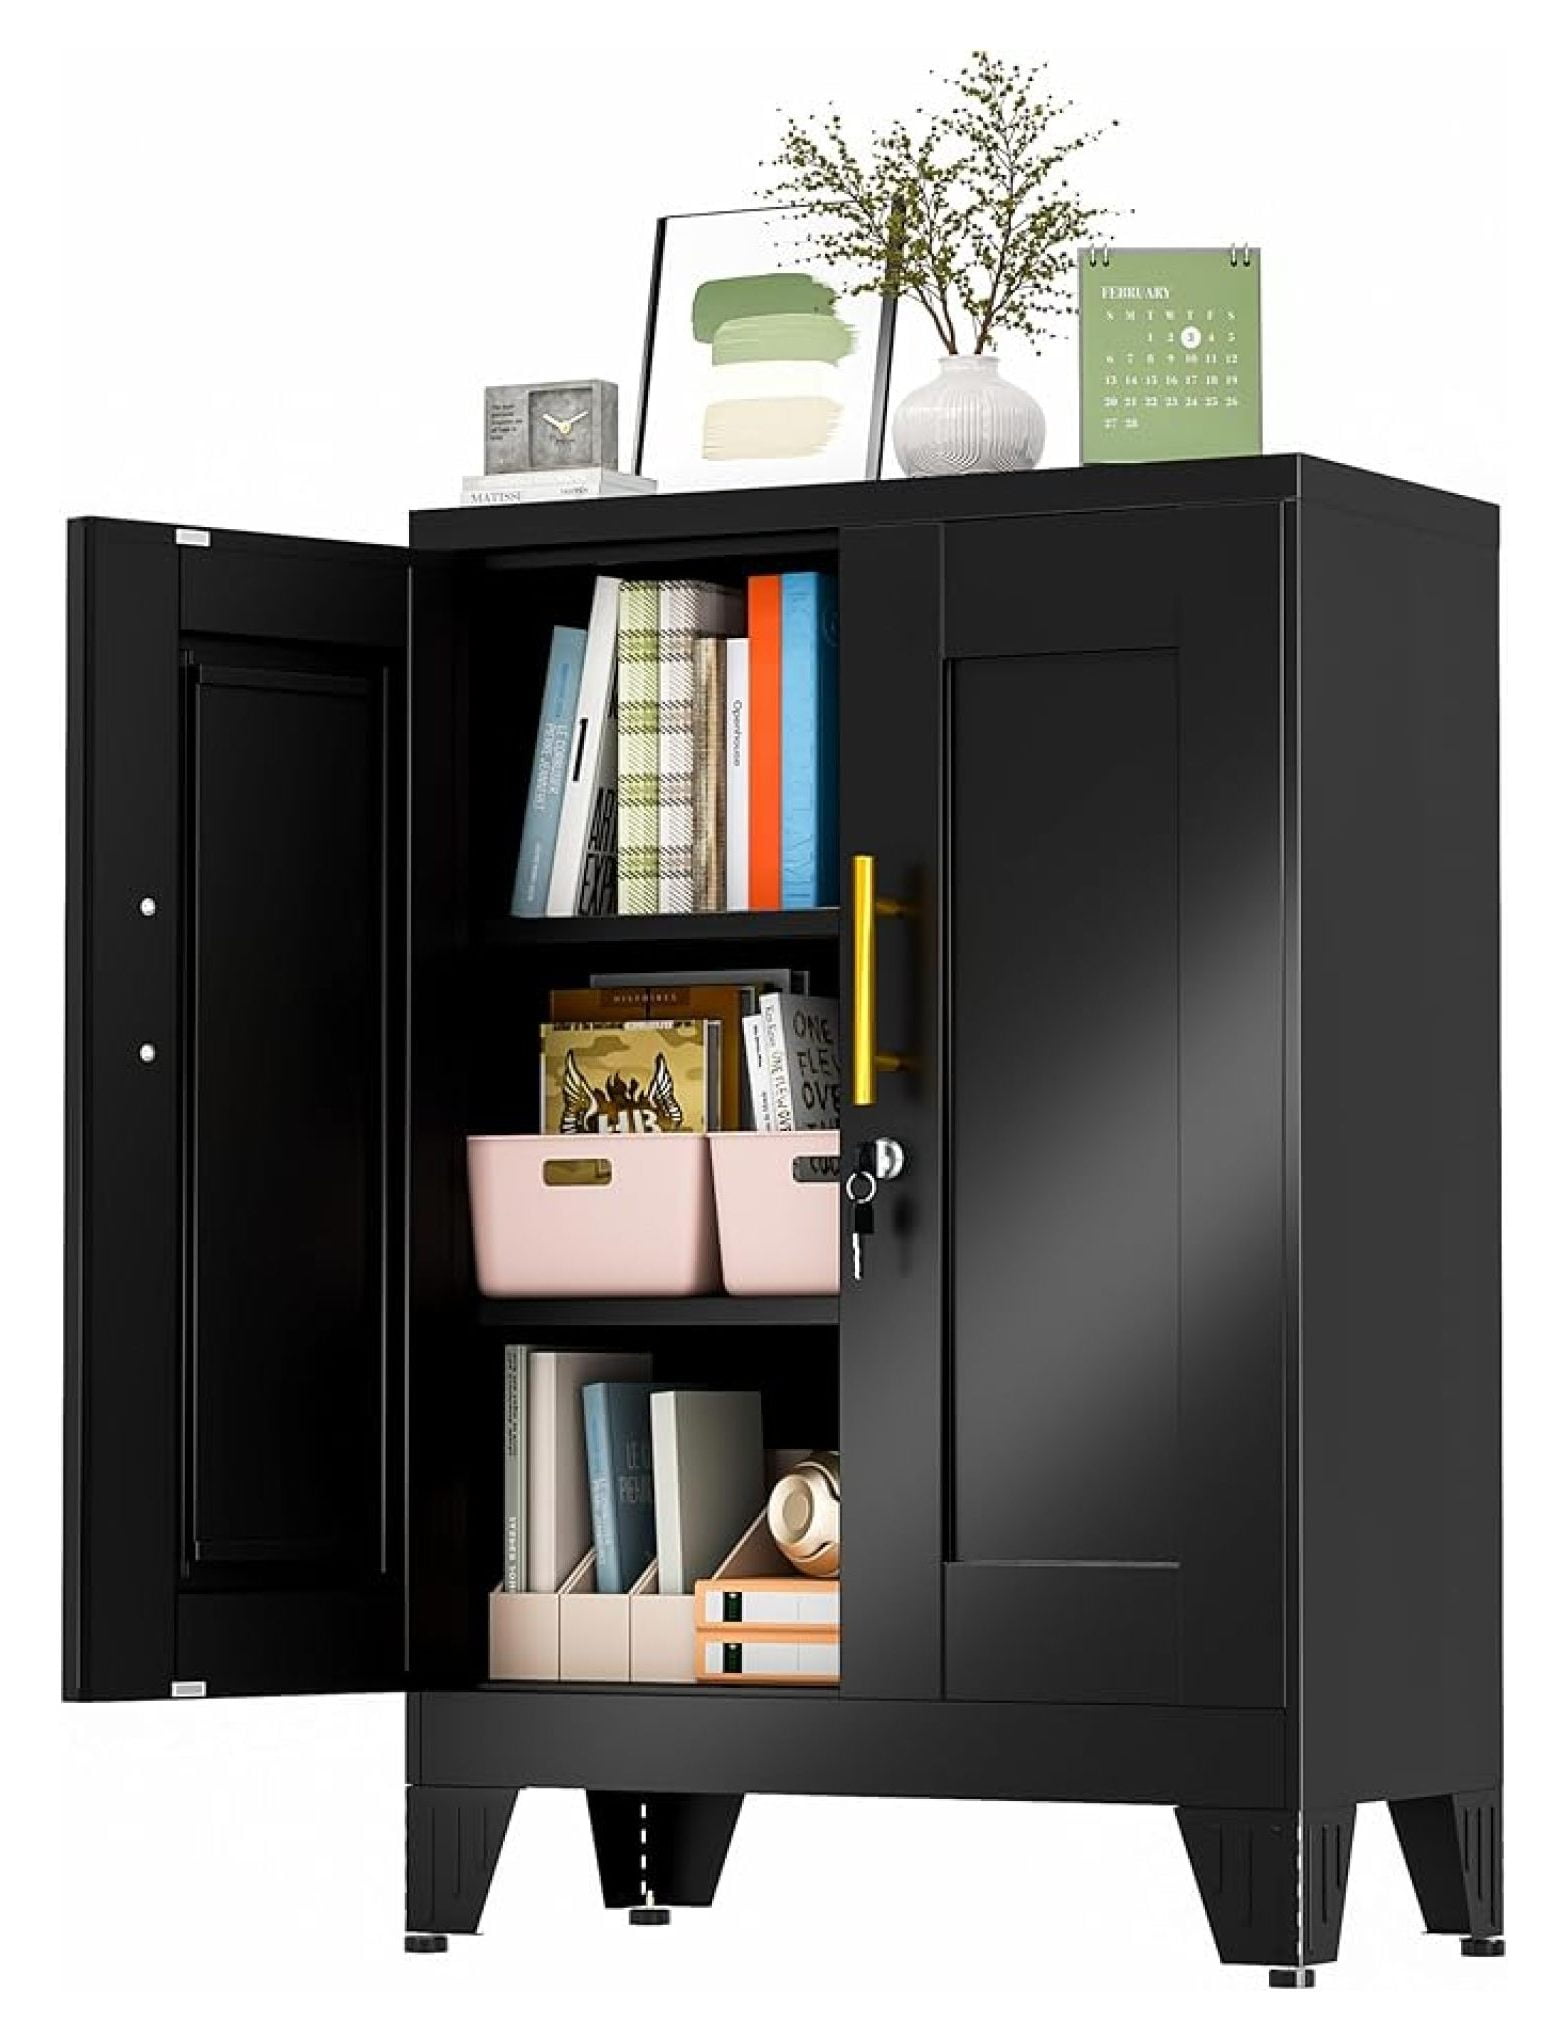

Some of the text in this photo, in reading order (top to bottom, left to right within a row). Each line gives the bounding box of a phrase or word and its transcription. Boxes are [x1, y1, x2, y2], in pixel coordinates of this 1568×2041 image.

[1101, 286, 1170, 300] FEBRUARY
[1167, 332, 1174, 342] 2
[1227, 332, 1236, 342] 5
[1205, 353, 1217, 363] 11
[1225, 353, 1238, 363] 12
[731, 700, 742, 767] Openhouse
[793, 1010, 834, 1045] ONE
